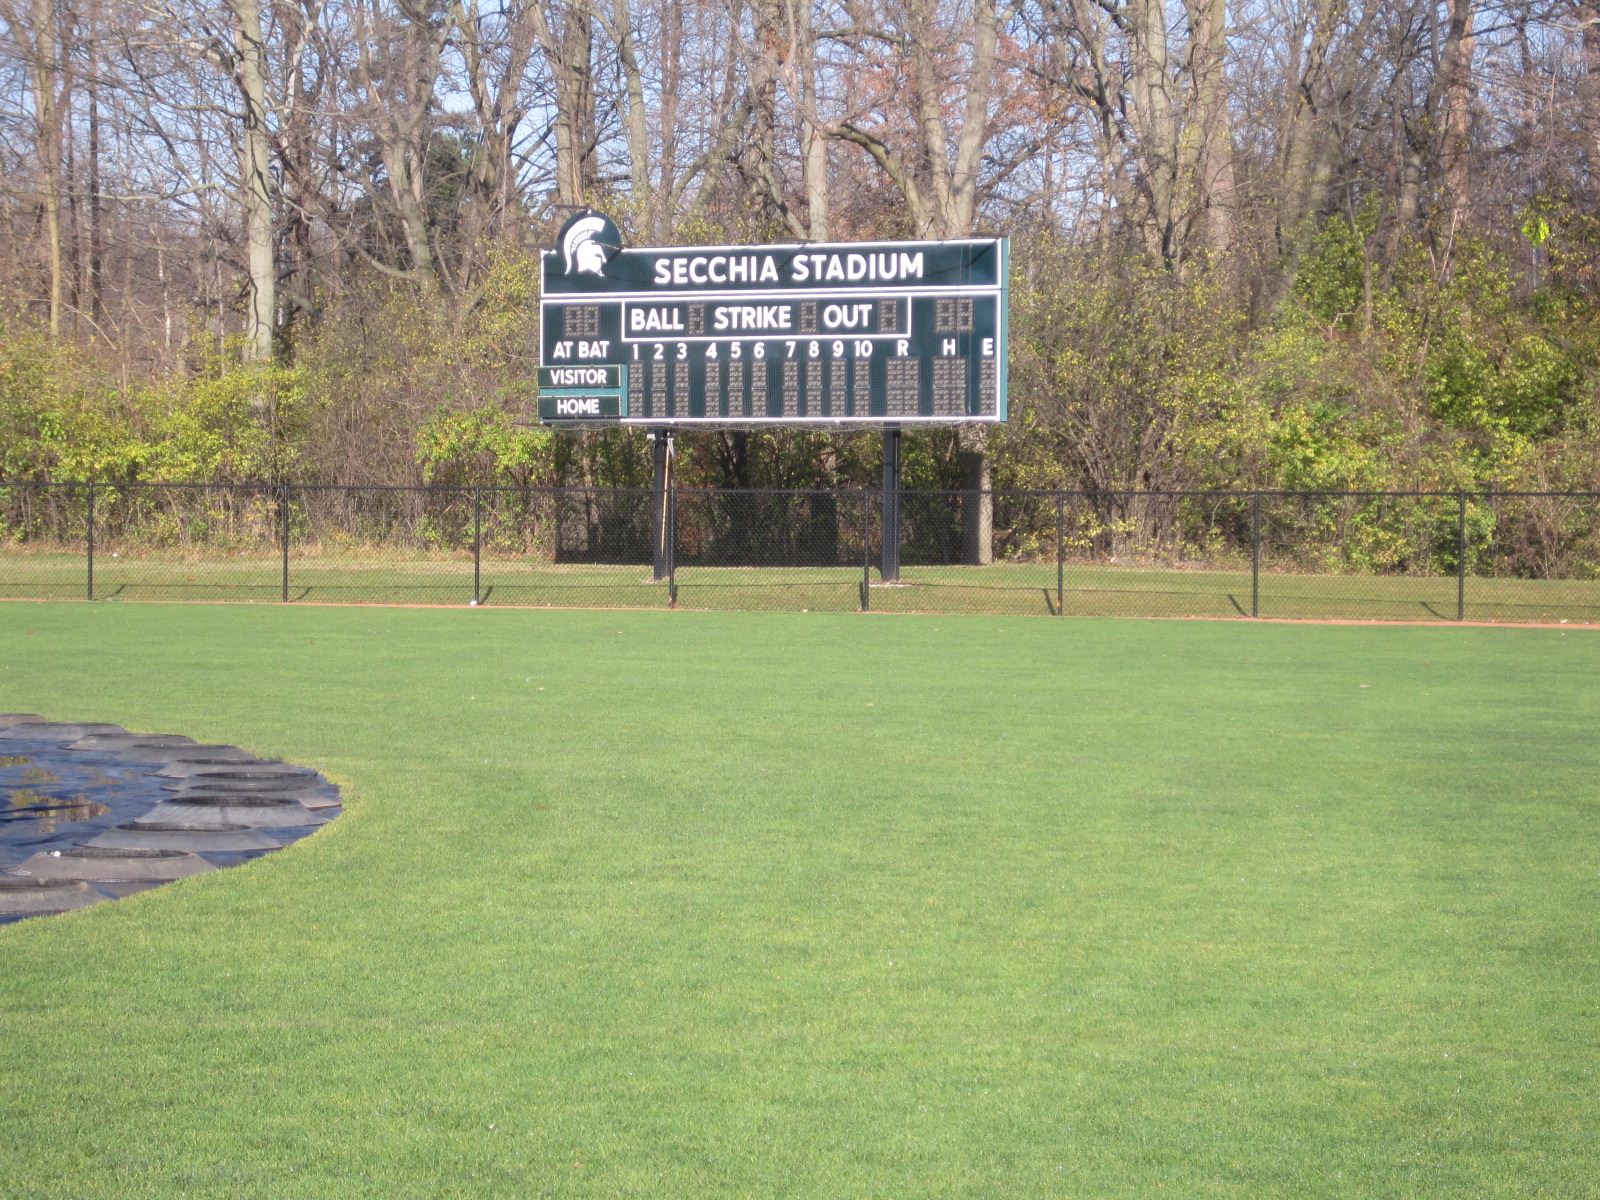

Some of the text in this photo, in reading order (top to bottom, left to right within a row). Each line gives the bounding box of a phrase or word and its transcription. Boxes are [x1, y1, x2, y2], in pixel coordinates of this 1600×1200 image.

[654, 252, 924, 285] SECCHIA STADIUM
[630, 304, 873, 331] BALL STRIKE OUT
[552, 340, 610, 359] AT BAT
[632, 337, 994, 360] 1 2 3 4 5 6 7 8 9 10 R H E
[549, 369, 607, 385] VISITOR
[557, 398, 600, 415] HOME
